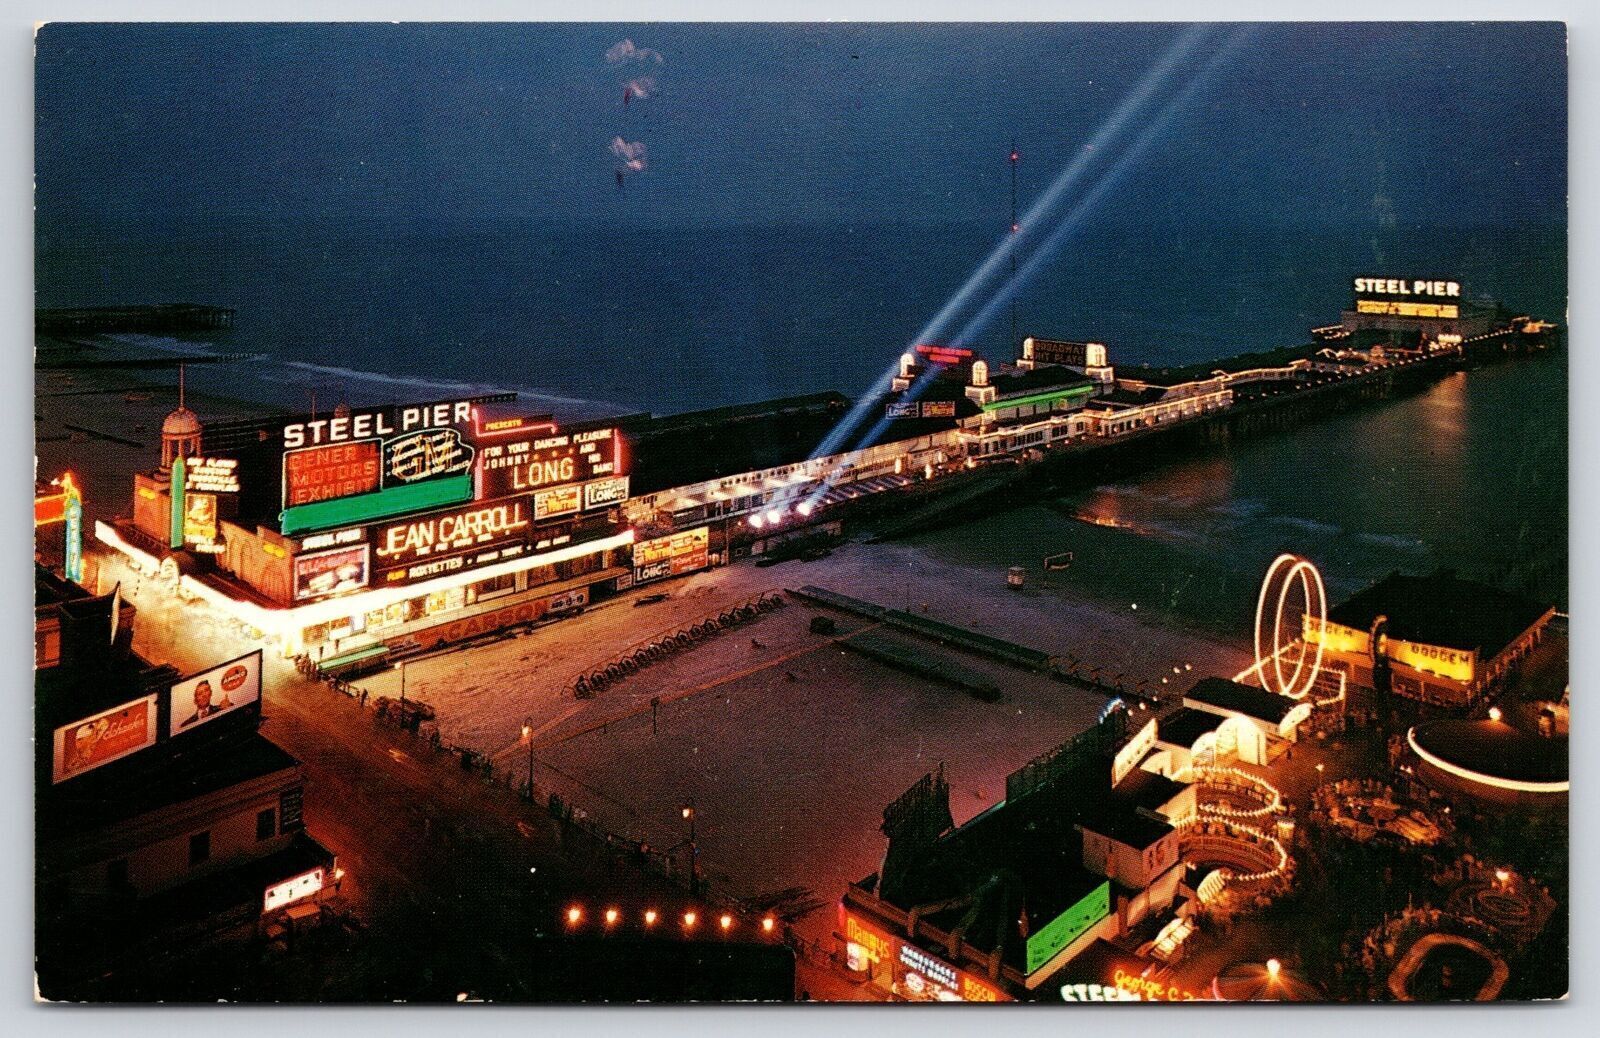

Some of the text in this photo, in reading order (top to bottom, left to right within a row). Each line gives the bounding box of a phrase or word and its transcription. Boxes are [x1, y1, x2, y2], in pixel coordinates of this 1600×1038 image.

[1354, 278, 1460, 296] STEEL PIER
[284, 401, 473, 449] STEEL PIER
[484, 429, 612, 458] FOR YOUR DANCING PLEASURE
[289, 443, 377, 471] GENERL
[483, 454, 529, 470] JOHNNY
[293, 460, 377, 486] MOTORS
[513, 457, 574, 489] LONG
[294, 478, 374, 504] EXHIBIT
[591, 485, 617, 503] LONG
[376, 521, 434, 556] JEAN
[439, 504, 528, 542] CARROLL
[636, 565, 663, 581] LONG
[1411, 645, 1470, 665] DODGEM
